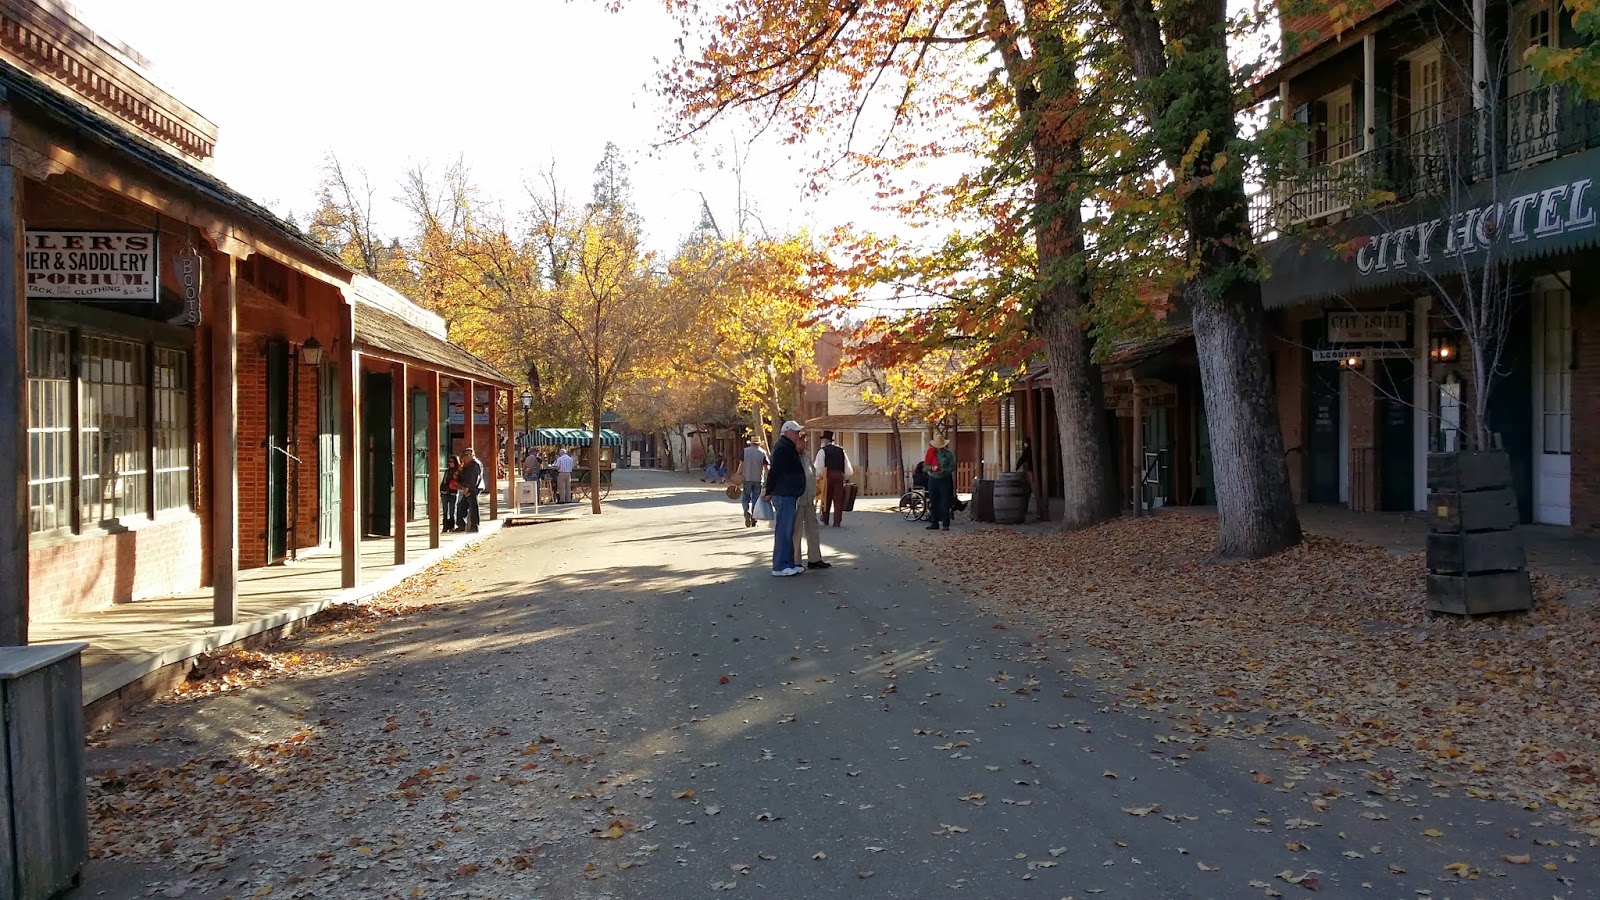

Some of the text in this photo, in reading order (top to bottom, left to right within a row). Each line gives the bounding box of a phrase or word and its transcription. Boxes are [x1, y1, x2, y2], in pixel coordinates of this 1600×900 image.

[1356, 178, 1597, 276] CITY HOTEL
[26, 235, 149, 251] LER'S
[53, 253, 65, 270] &
[68, 252, 149, 272] SADDLERY
[74, 285, 121, 296] CLOTHING
[183, 258, 196, 323] BOOTS
